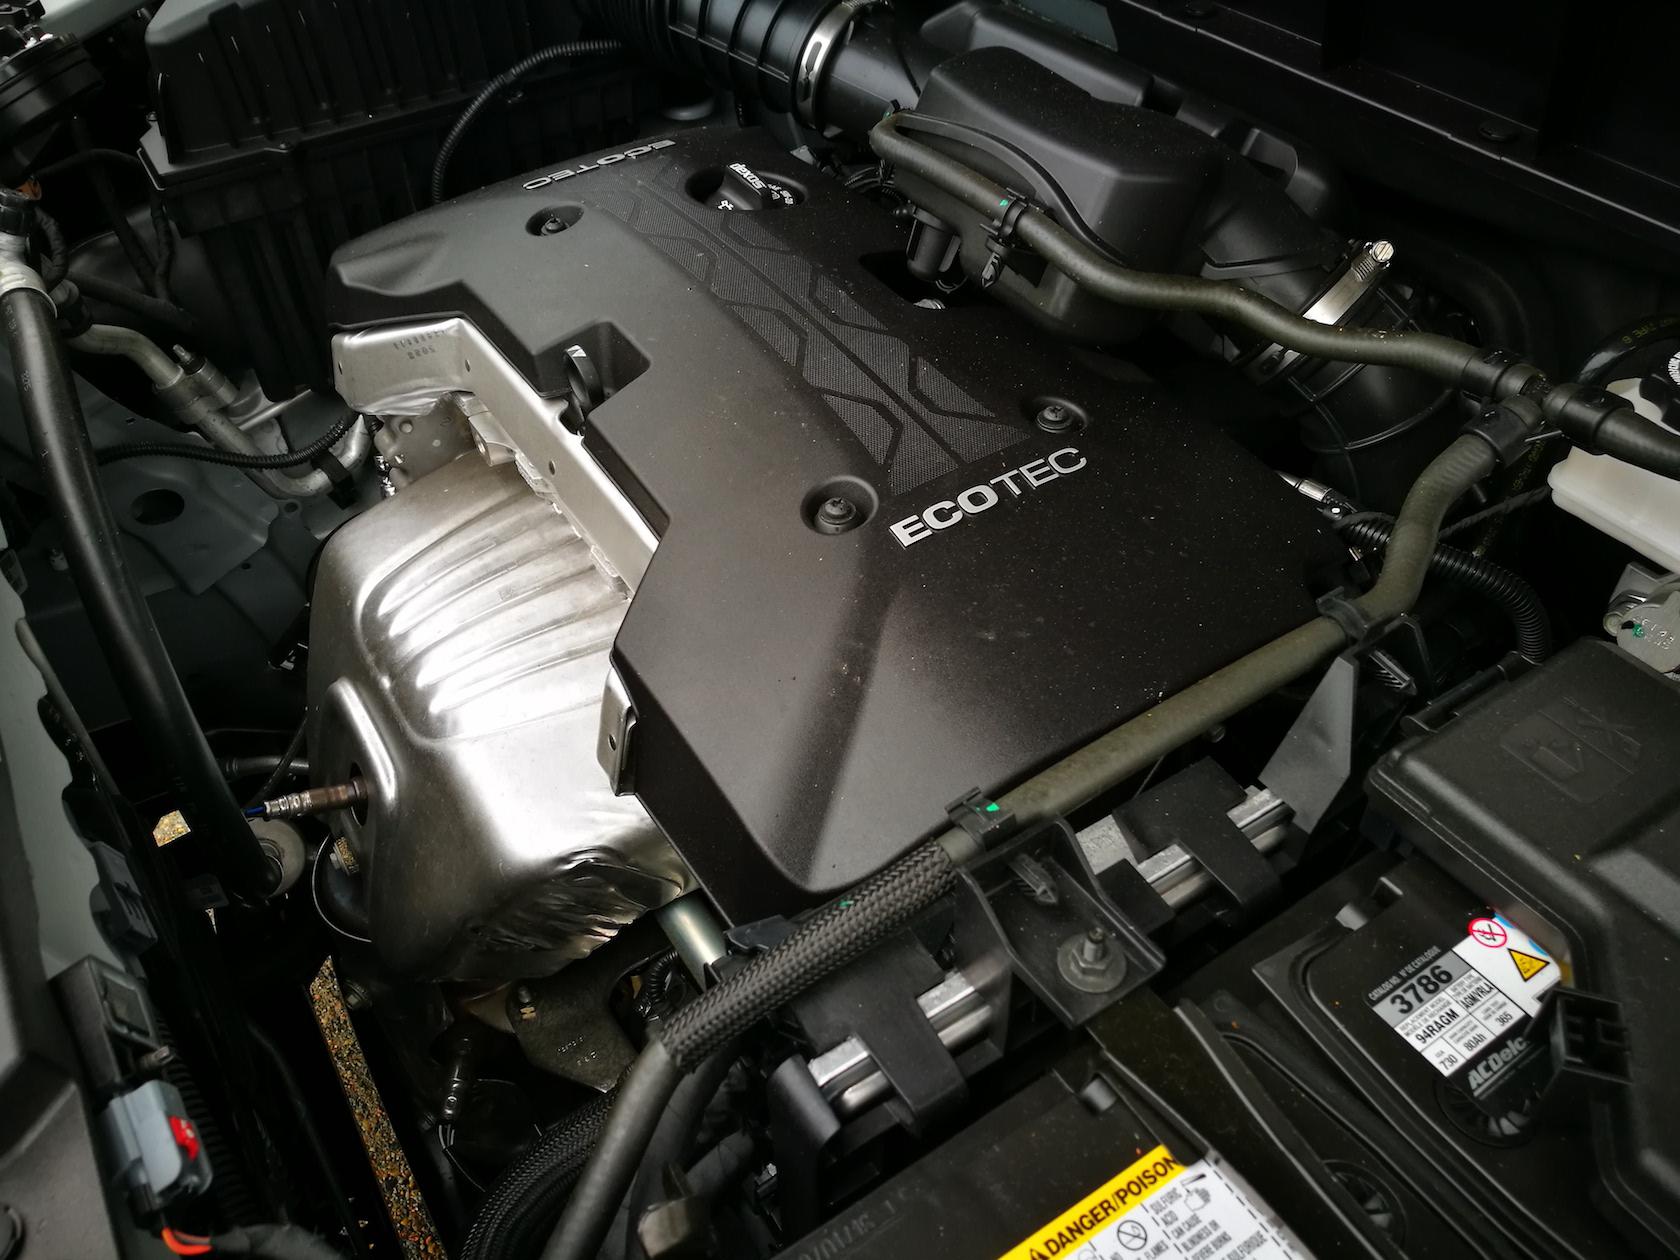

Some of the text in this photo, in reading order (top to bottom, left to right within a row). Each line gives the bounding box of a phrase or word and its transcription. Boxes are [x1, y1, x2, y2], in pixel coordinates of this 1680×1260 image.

[522, 139, 676, 191] ECOTEC
[729, 162, 767, 190] dexos
[889, 447, 1087, 549] ECOTEC
[1390, 965, 1453, 1014] 3786
[1460, 982, 1495, 1009] AGM/VRLA
[1415, 1008, 1460, 1044] 94RAGM
[1496, 1011, 1513, 1026] 365
[1463, 1033, 1487, 1052] 80Ah
[1439, 1054, 1458, 1071] 730
[1467, 1035, 1530, 1090] ACDelc
[1043, 1154, 1179, 1257] DANGER/POISON
